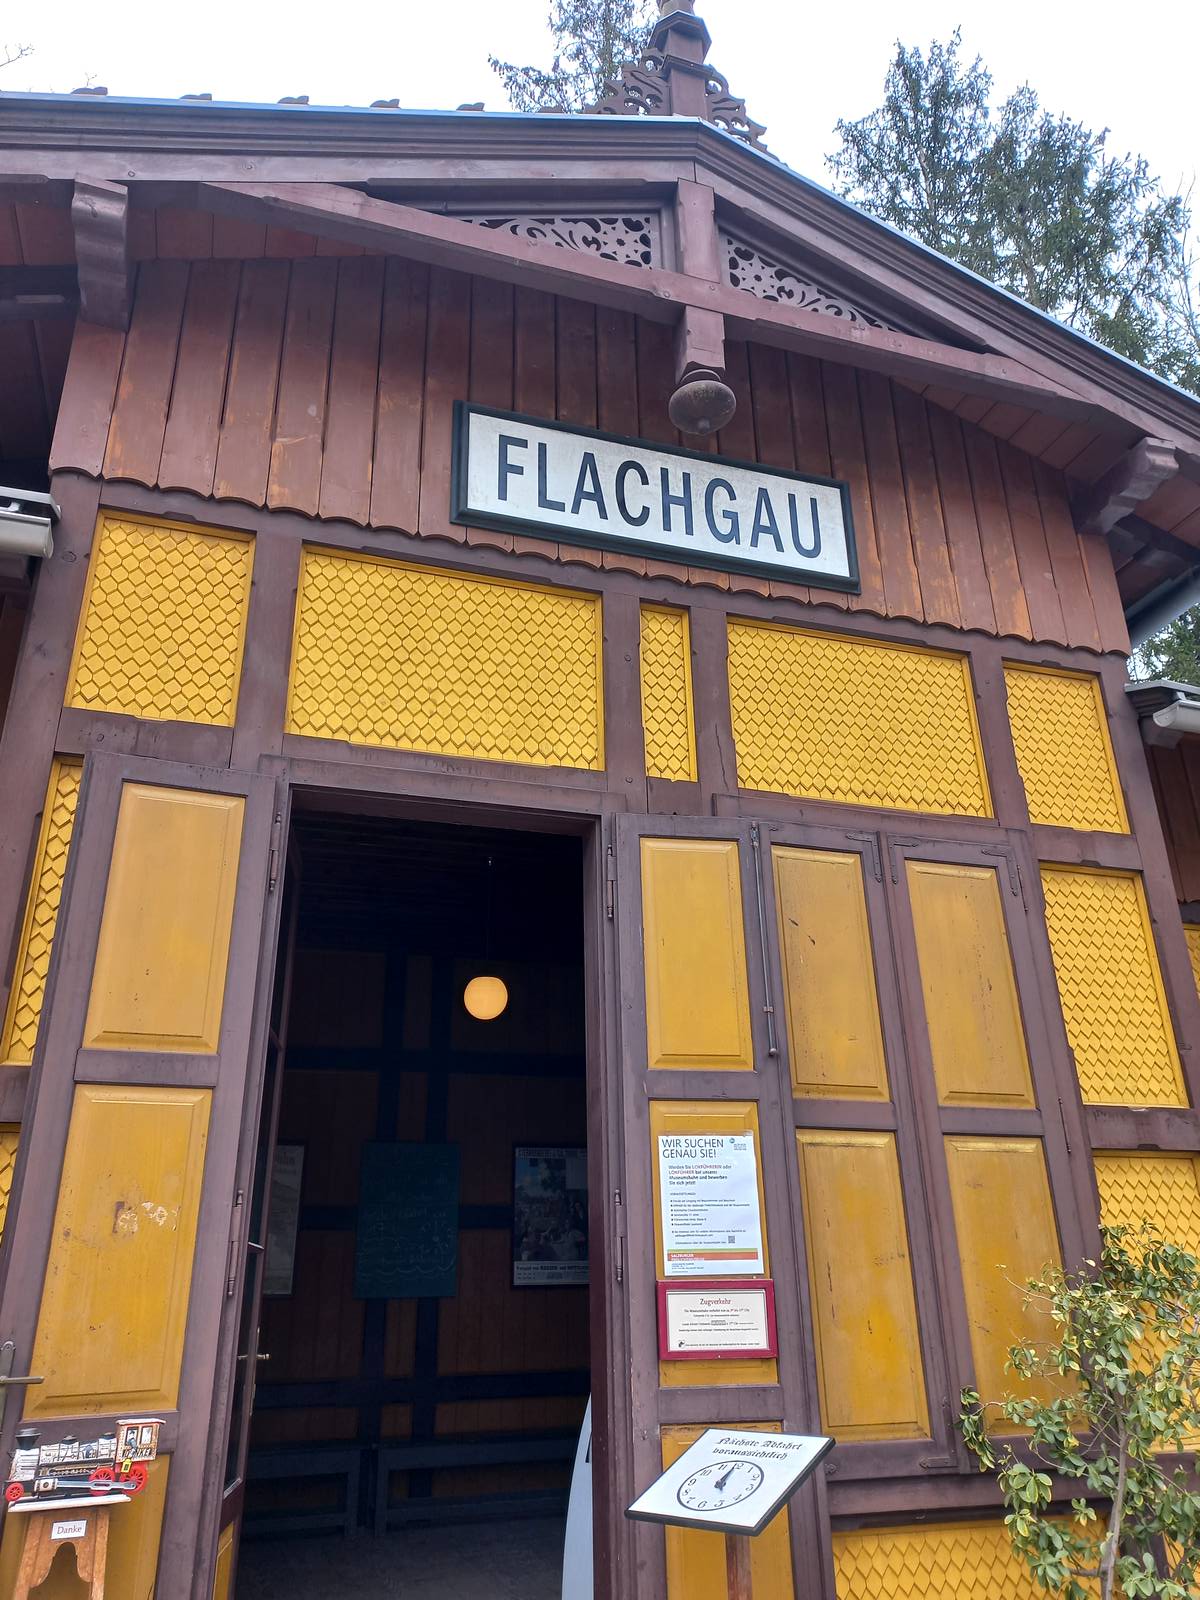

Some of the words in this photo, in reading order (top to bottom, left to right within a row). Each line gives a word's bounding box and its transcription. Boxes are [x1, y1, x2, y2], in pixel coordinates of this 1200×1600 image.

[497, 433, 823, 559] FLACHGAU
[662, 1138, 682, 1148] WIR
[684, 1138, 724, 1148] SUCHEN
[662, 1148, 697, 1159] GENAU
[700, 1148, 717, 1159] SIE!
[699, 1298, 731, 1306] Zugverkehr
[715, 1437, 760, 1447] Nächste
[761, 1439, 803, 1450] Abfahrt
[712, 1447, 788, 1460] voraussichtlich
[750, 1473, 760, 1481] 2
[687, 1478, 697, 1486] 9
[745, 1483, 754, 1491] 3
[686, 1496, 696, 1504] 7
[697, 1500, 708, 1508] 6
[56, 1525, 83, 1535] Danke
